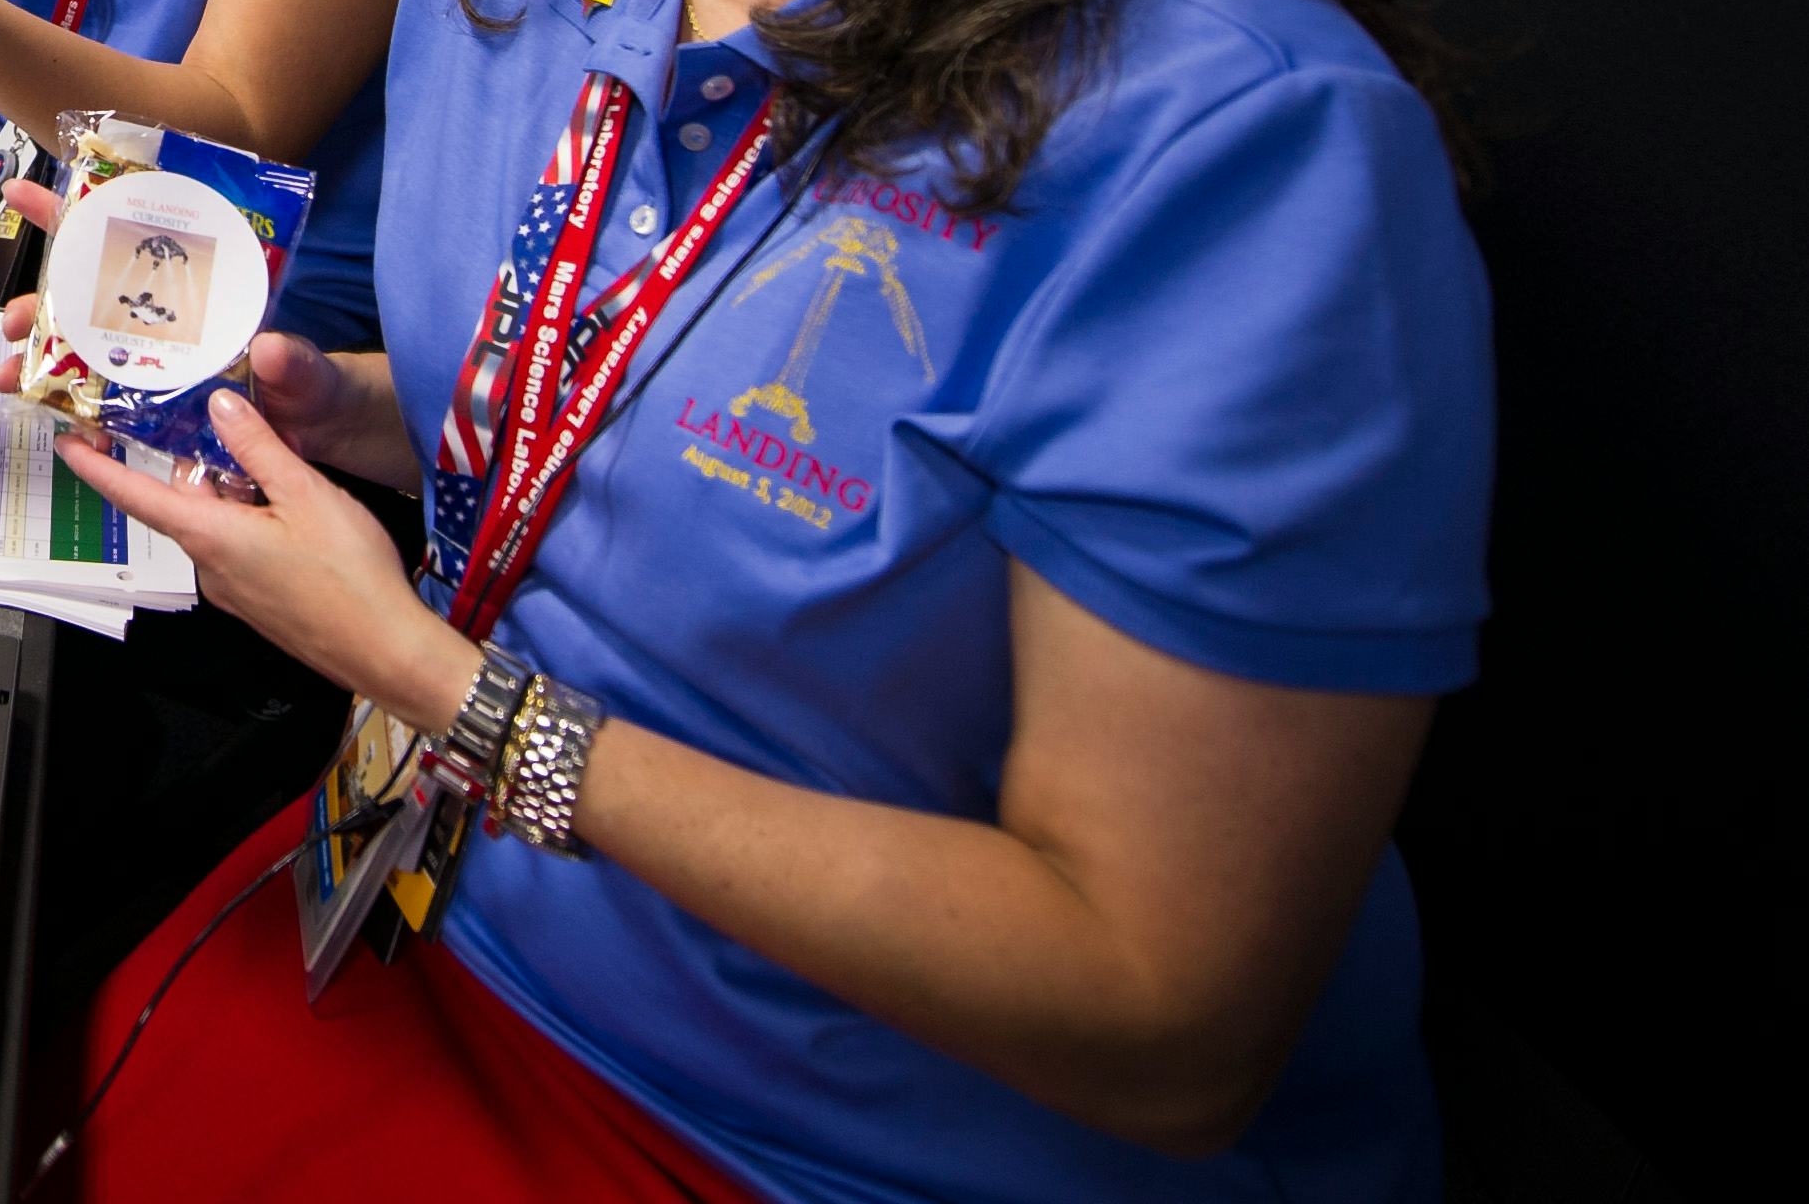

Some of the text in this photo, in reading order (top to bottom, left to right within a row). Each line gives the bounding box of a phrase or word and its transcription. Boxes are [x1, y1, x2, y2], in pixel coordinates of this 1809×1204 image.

[127, 197, 199, 220] MSL LANDING
[568, 105, 622, 230] Laboratory
[658, 133, 769, 281] Mars Science
[132, 211, 191, 230] CURIOSITY
[814, 175, 1000, 252] COSITY
[471, 269, 525, 366] JPL
[542, 261, 576, 320] Mars
[101, 332, 145, 347] AUGUST
[134, 355, 165, 370] JPL
[520, 324, 558, 424] Science
[566, 306, 647, 429] Laboratory
[675, 397, 871, 513] LANDING
[681, 444, 751, 489] August
[776, 487, 832, 529] 2012
